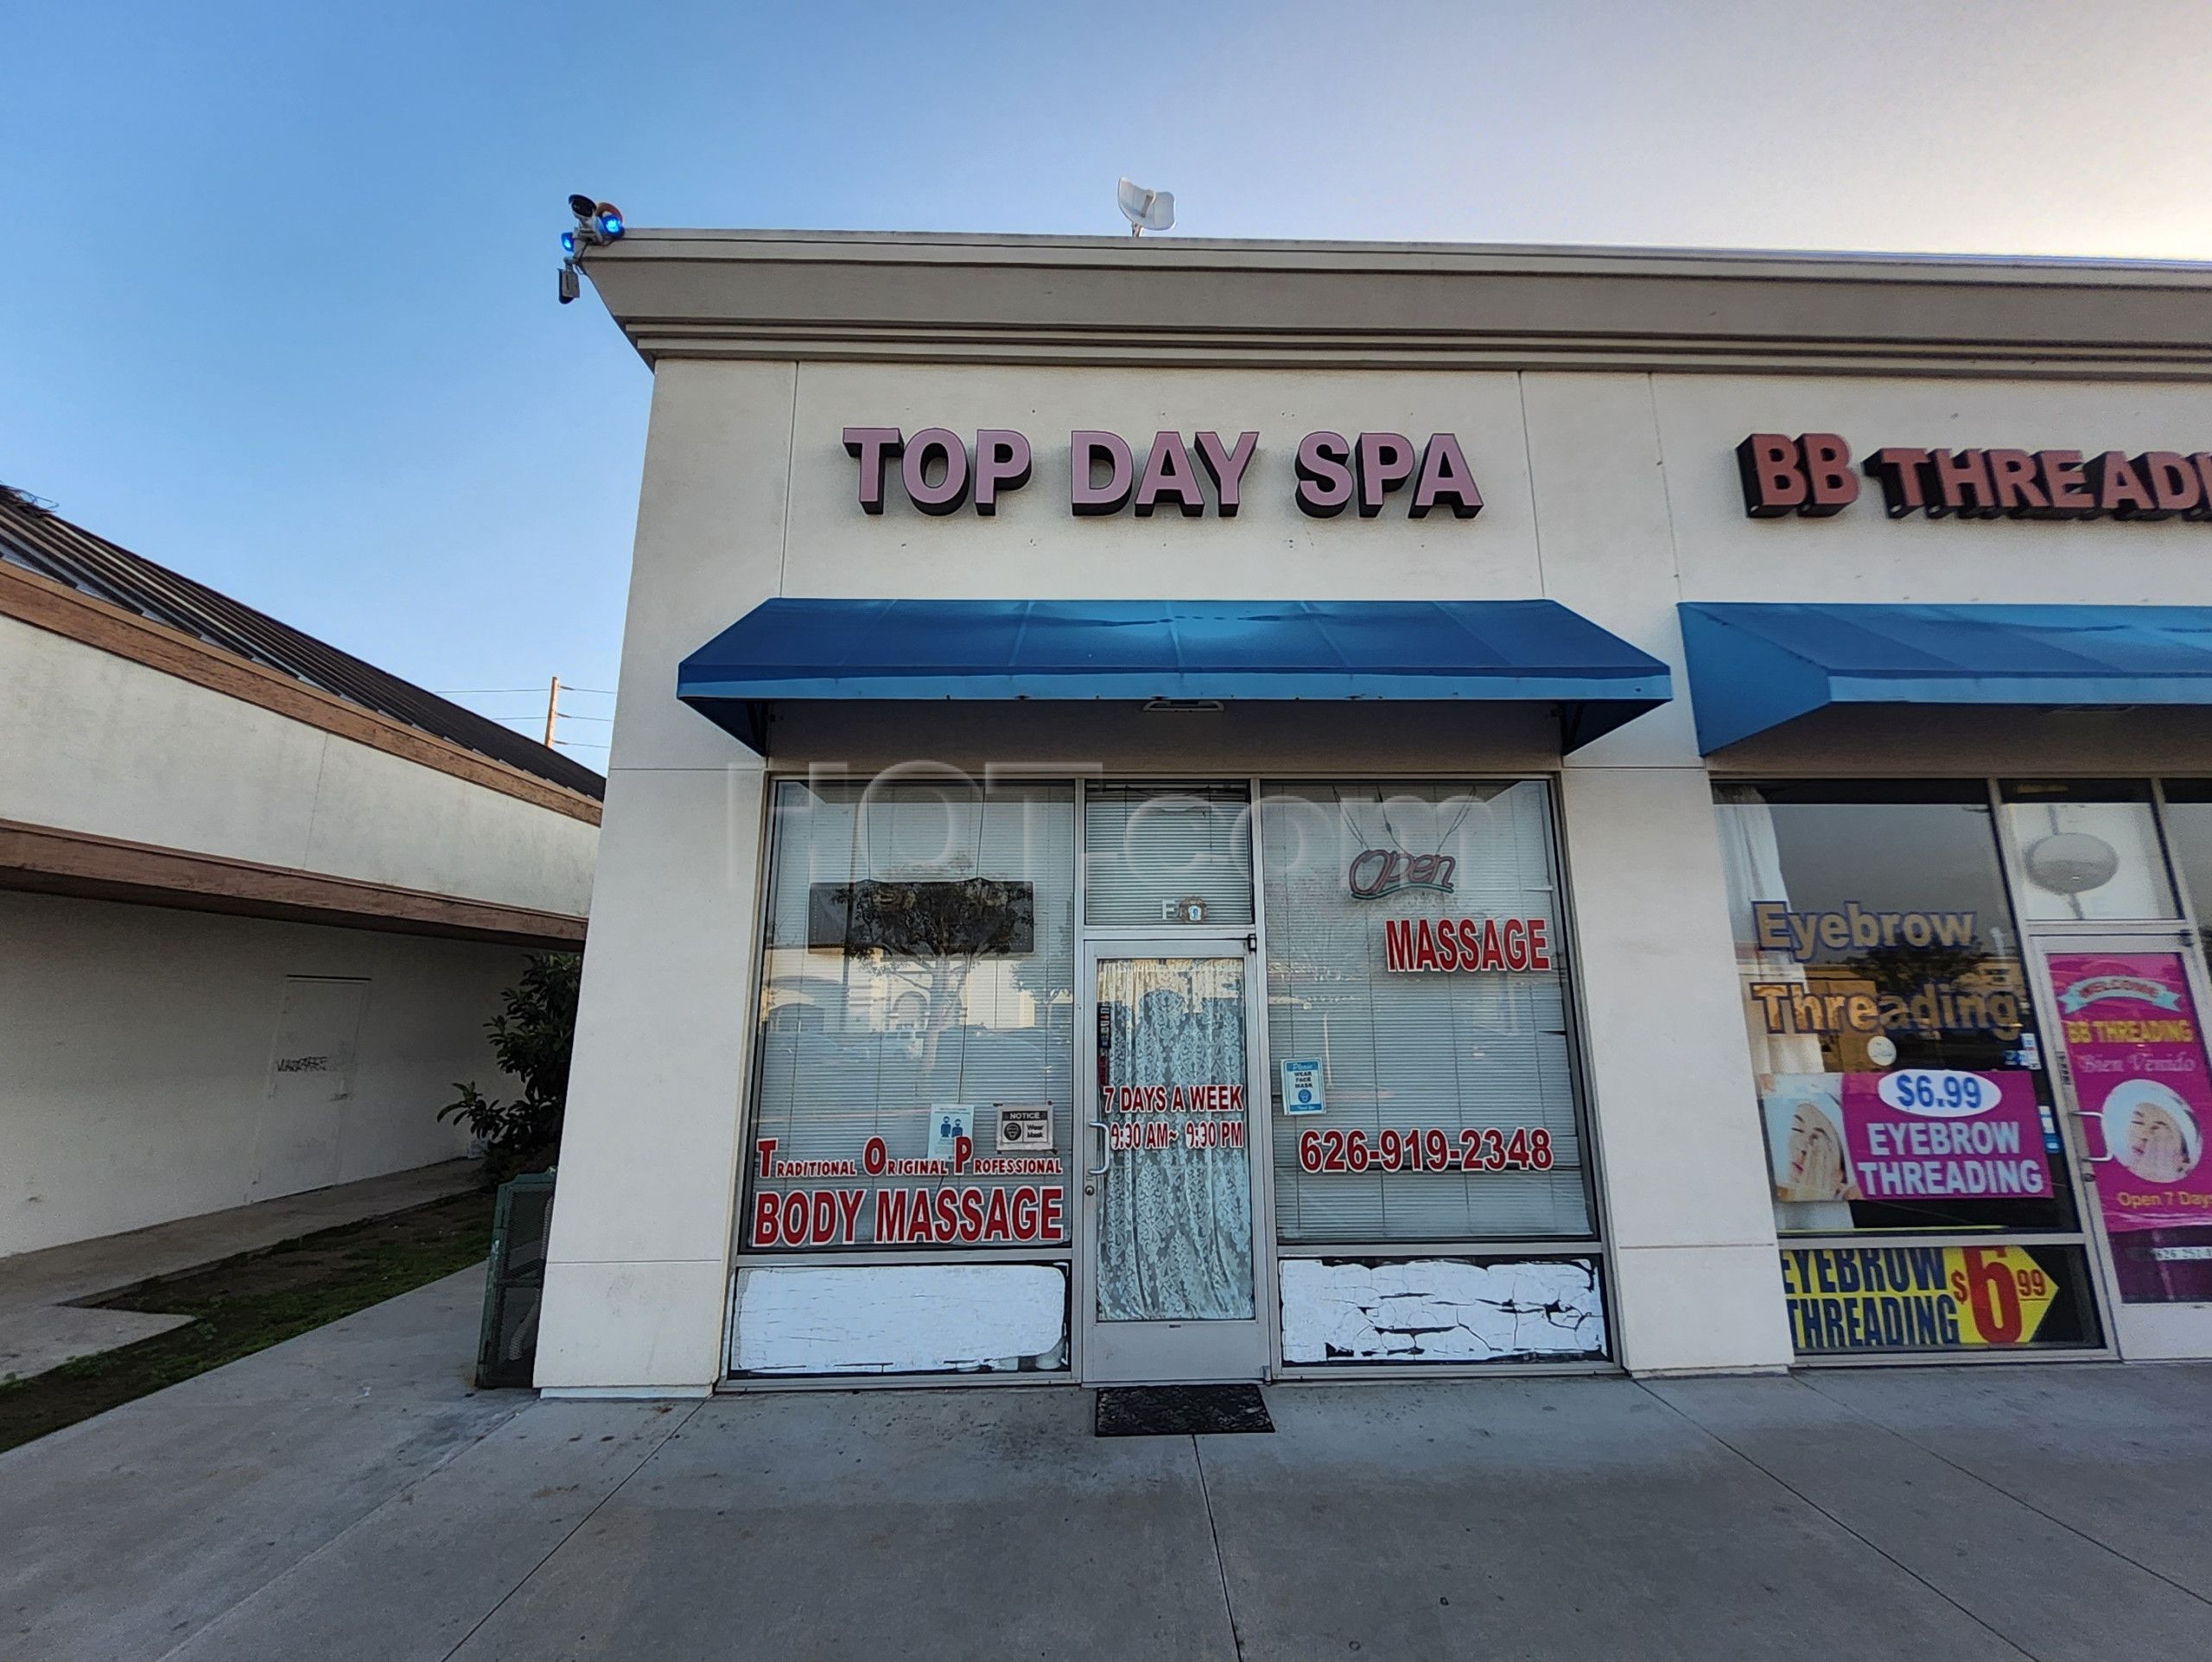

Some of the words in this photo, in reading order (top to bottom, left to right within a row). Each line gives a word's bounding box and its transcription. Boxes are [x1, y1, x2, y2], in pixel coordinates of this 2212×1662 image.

[843, 427, 1031, 515] TOP
[1071, 430, 1260, 517] DAY
[1295, 430, 1483, 518] SPA
[1736, 433, 1861, 518] BB
[1349, 849, 1456, 895] Open
[1385, 918, 1551, 973] MASSAGE
[1751, 901, 1977, 963] Eyebrow
[1750, 982, 2020, 1041] Threading
[2093, 1019, 2194, 1042] THREADING
[1103, 1086, 1115, 1112] 7
[1120, 1085, 1166, 1112] DAYS
[1171, 1085, 1185, 1112] A
[1188, 1085, 1243, 1111] WEEK
[1896, 1073, 1982, 1110] $6.99
[1009, 1111, 1041, 1120] NOTICE
[1110, 1122, 1141, 1149] 9:30
[1185, 1120, 1217, 1149] 9:30
[1220, 1120, 1243, 1148] PM
[757, 1137, 857, 1177] TRADITIONAL
[863, 1135, 949, 1175] ORIGINAL
[954, 1136, 1064, 1175] PROFESSIONAL
[1300, 1128, 1554, 1174] 626-919-2348
[1866, 1121, 2021, 1156] EYEBROW
[1857, 1160, 2044, 1195] THREADING
[753, 1188, 867, 1247] BODY
[874, 1186, 1064, 1245] MASSAGE
[2118, 1192, 2161, 1208] Open
